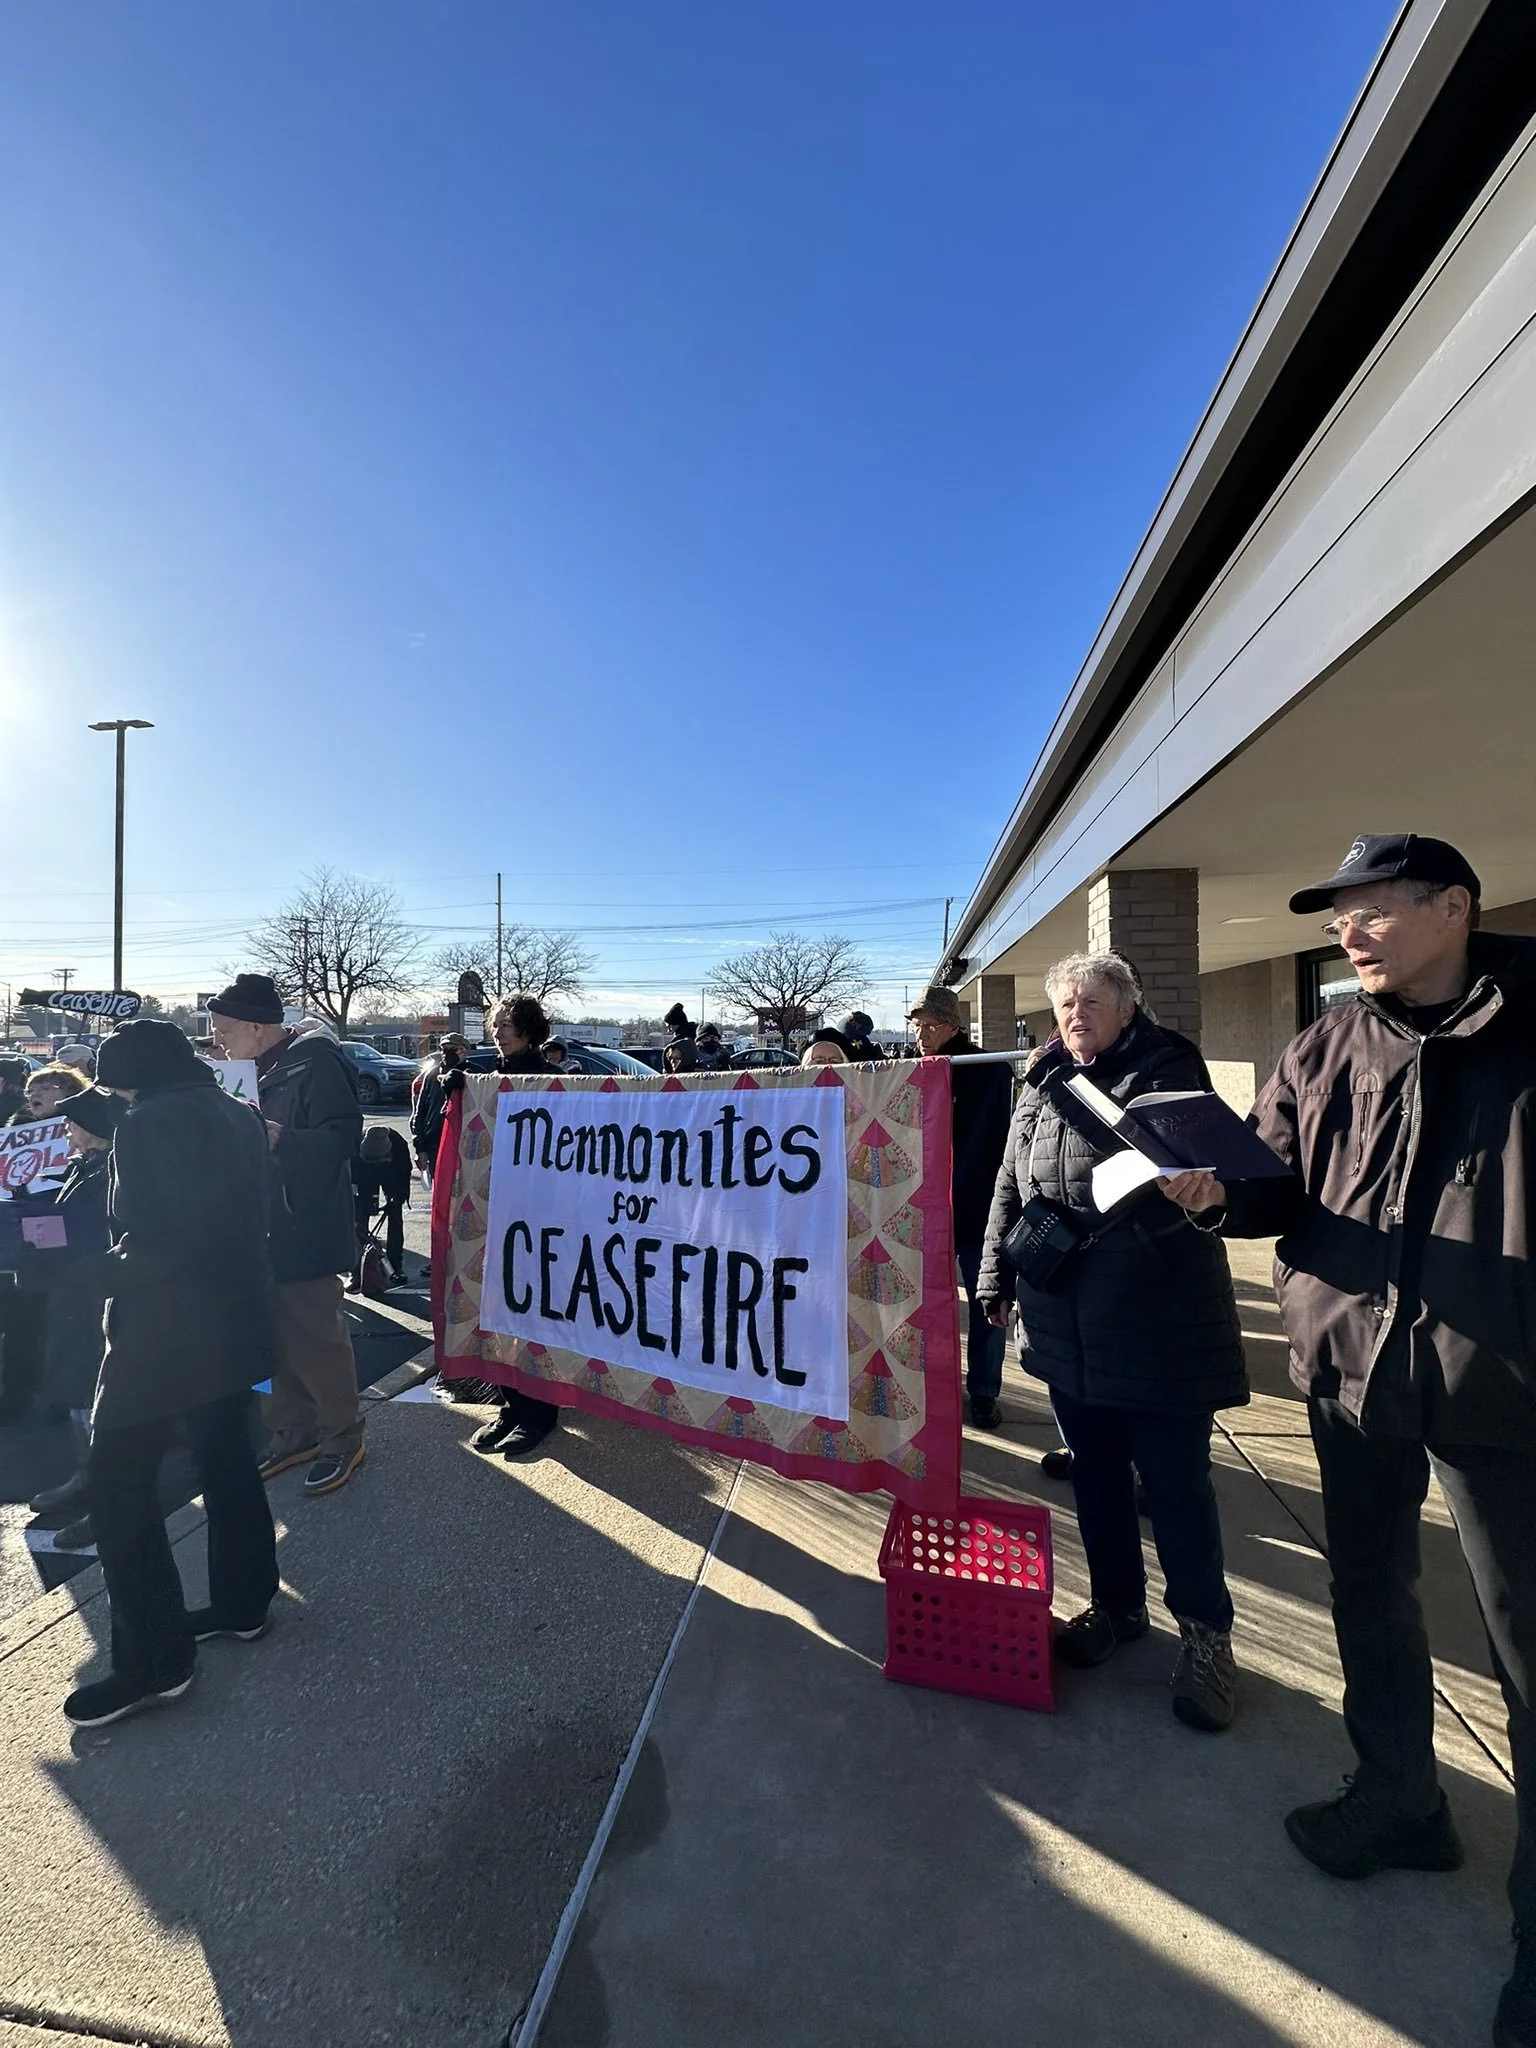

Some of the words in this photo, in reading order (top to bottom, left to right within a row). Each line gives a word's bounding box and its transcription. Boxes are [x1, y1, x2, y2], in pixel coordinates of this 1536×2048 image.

[508, 1104, 821, 1195] Mennonites
[608, 1193, 658, 1225] for
[503, 1220, 809, 1387] CEASEFIRE
